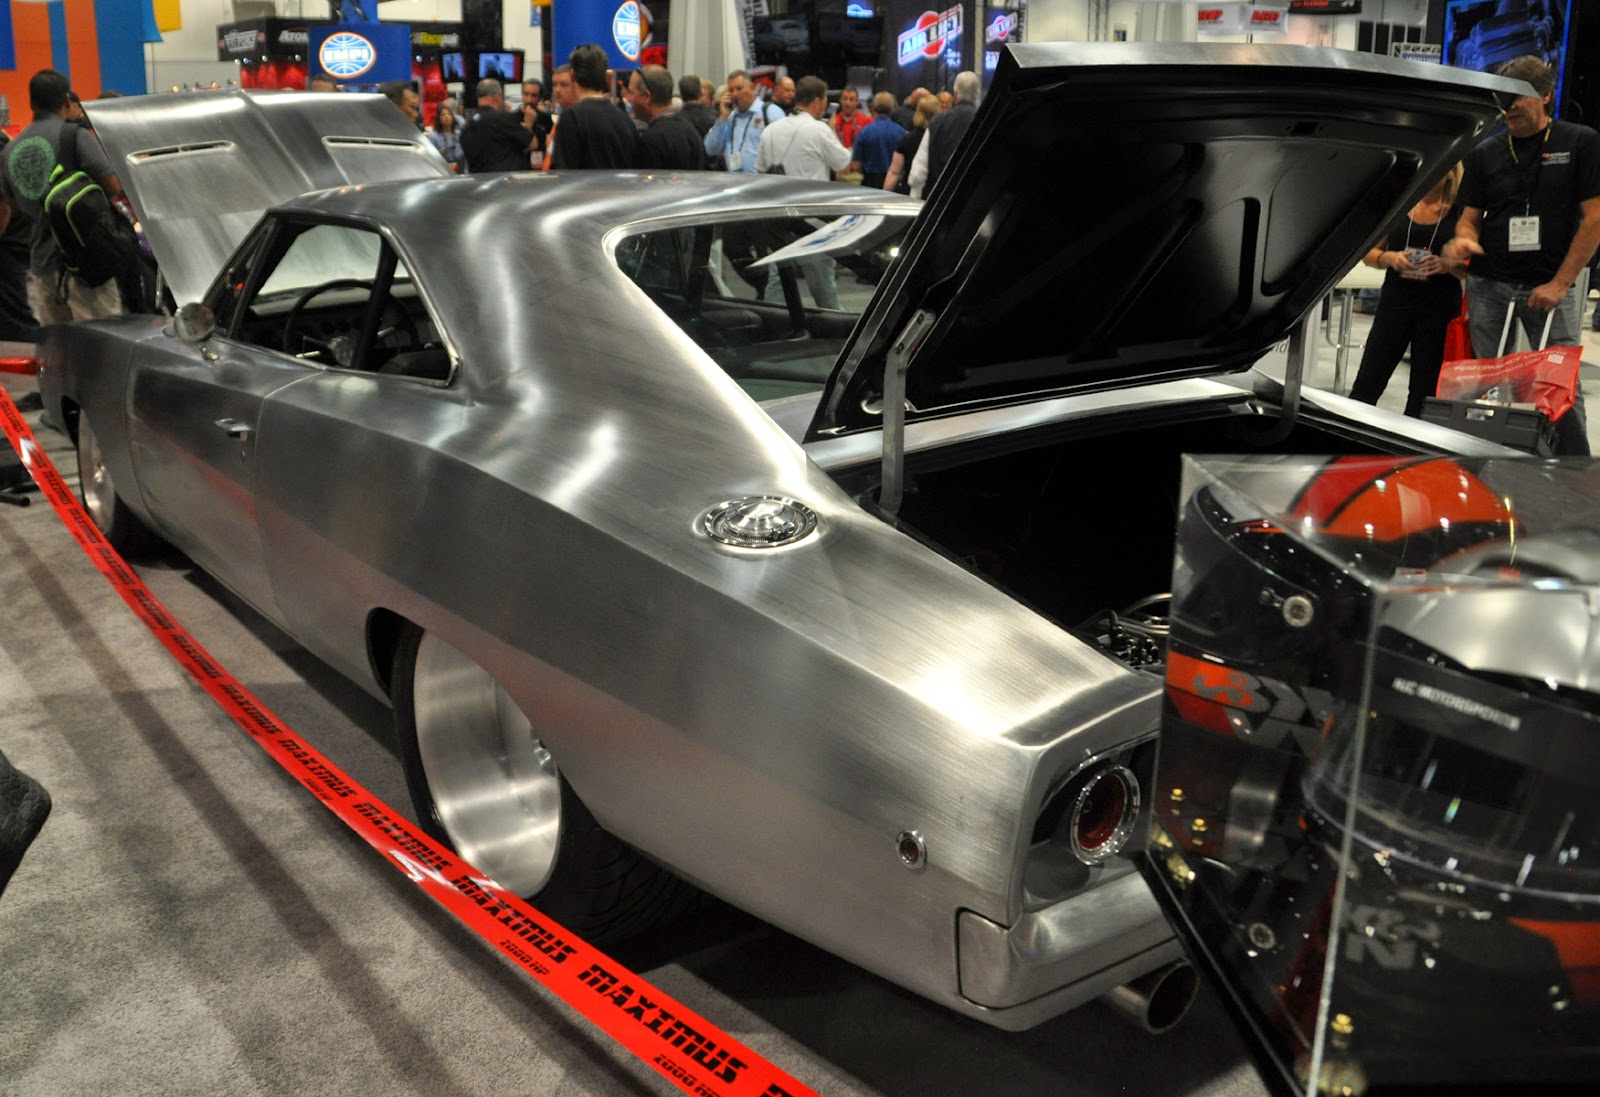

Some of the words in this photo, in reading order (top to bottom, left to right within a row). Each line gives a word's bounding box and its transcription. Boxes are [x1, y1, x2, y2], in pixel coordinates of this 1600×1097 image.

[323, 48, 370, 62] EMPI
[901, 30, 928, 57] AIR
[1454, 356, 1522, 372] PERFORMANCE
[170, 634, 224, 679] MAXIMUS
[217, 684, 284, 735] MAXIMUS
[276, 739, 358, 798] MAXIMUS
[352, 802, 453, 873] MAXIMUS
[450, 875, 578, 964] MAXIMUS
[576, 964, 749, 1085] MAXIMUS
